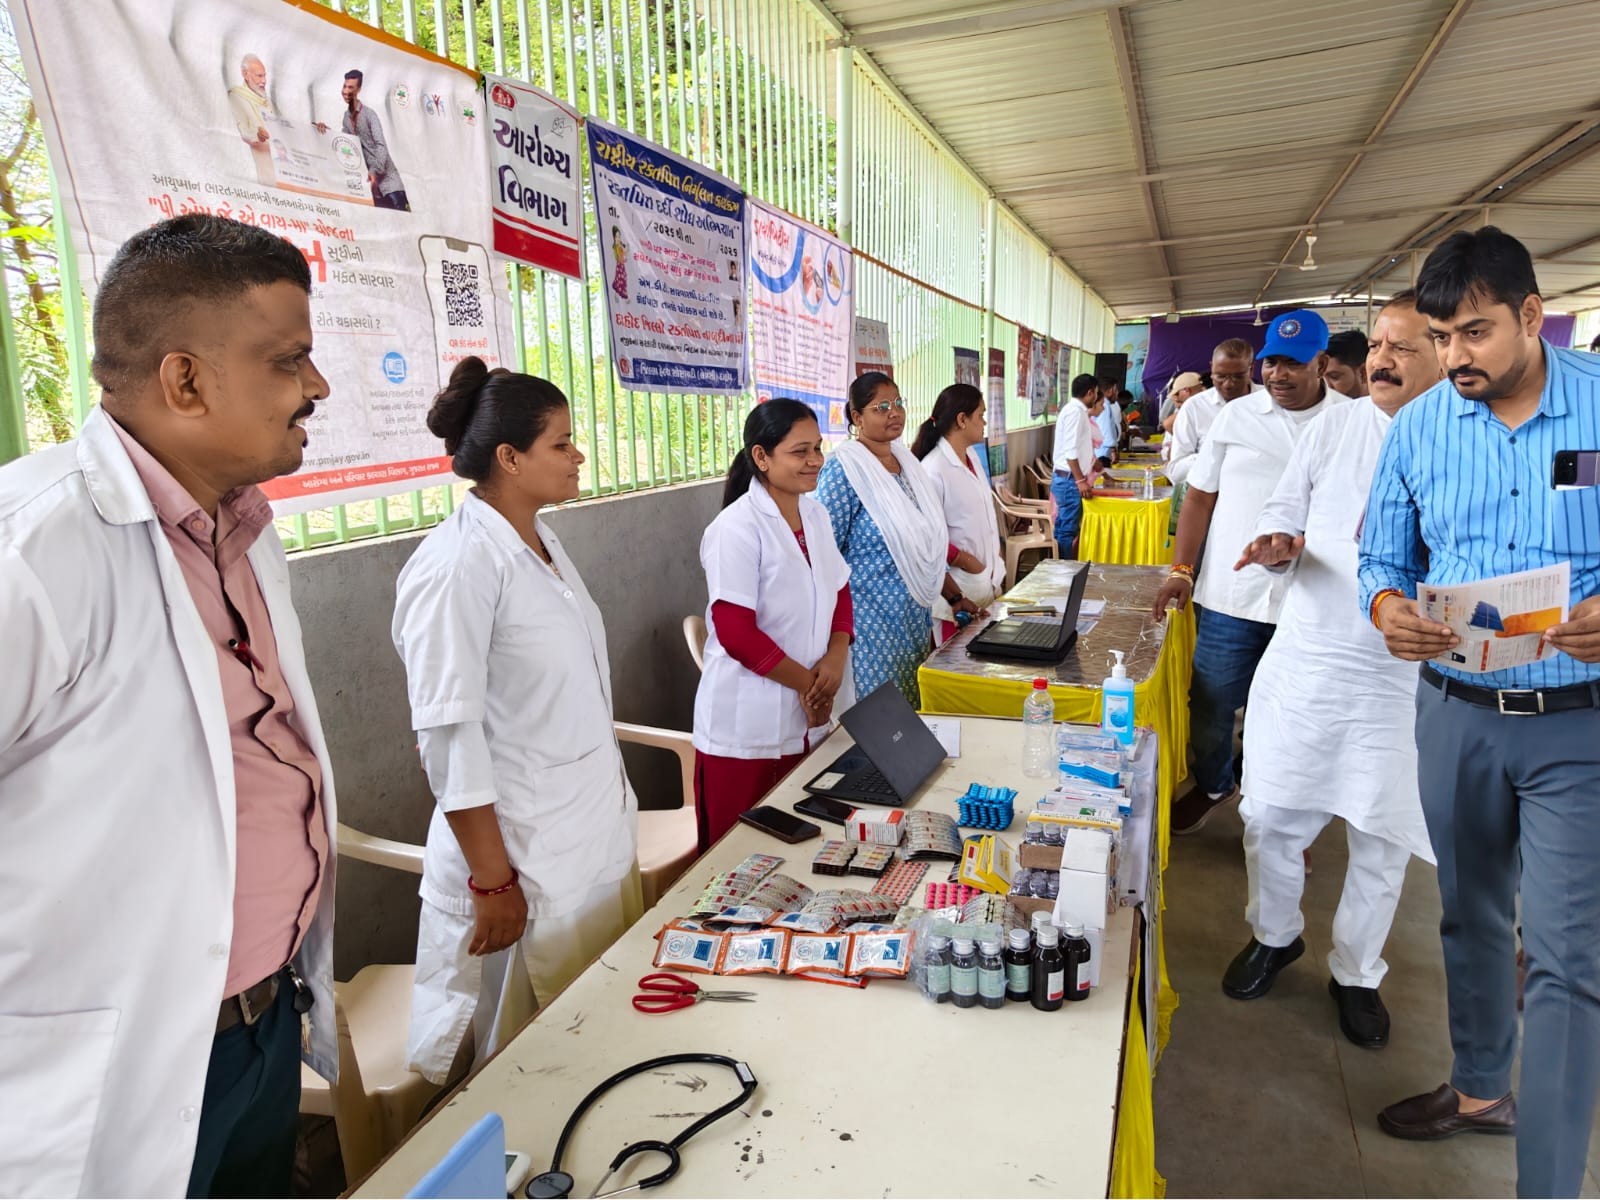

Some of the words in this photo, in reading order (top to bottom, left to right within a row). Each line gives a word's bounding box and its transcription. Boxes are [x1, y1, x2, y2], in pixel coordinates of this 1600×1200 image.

[493, 118, 571, 179] આરોગ્ય
[498, 164, 569, 226] વિભાગ
[313, 219, 355, 242] યોજના
